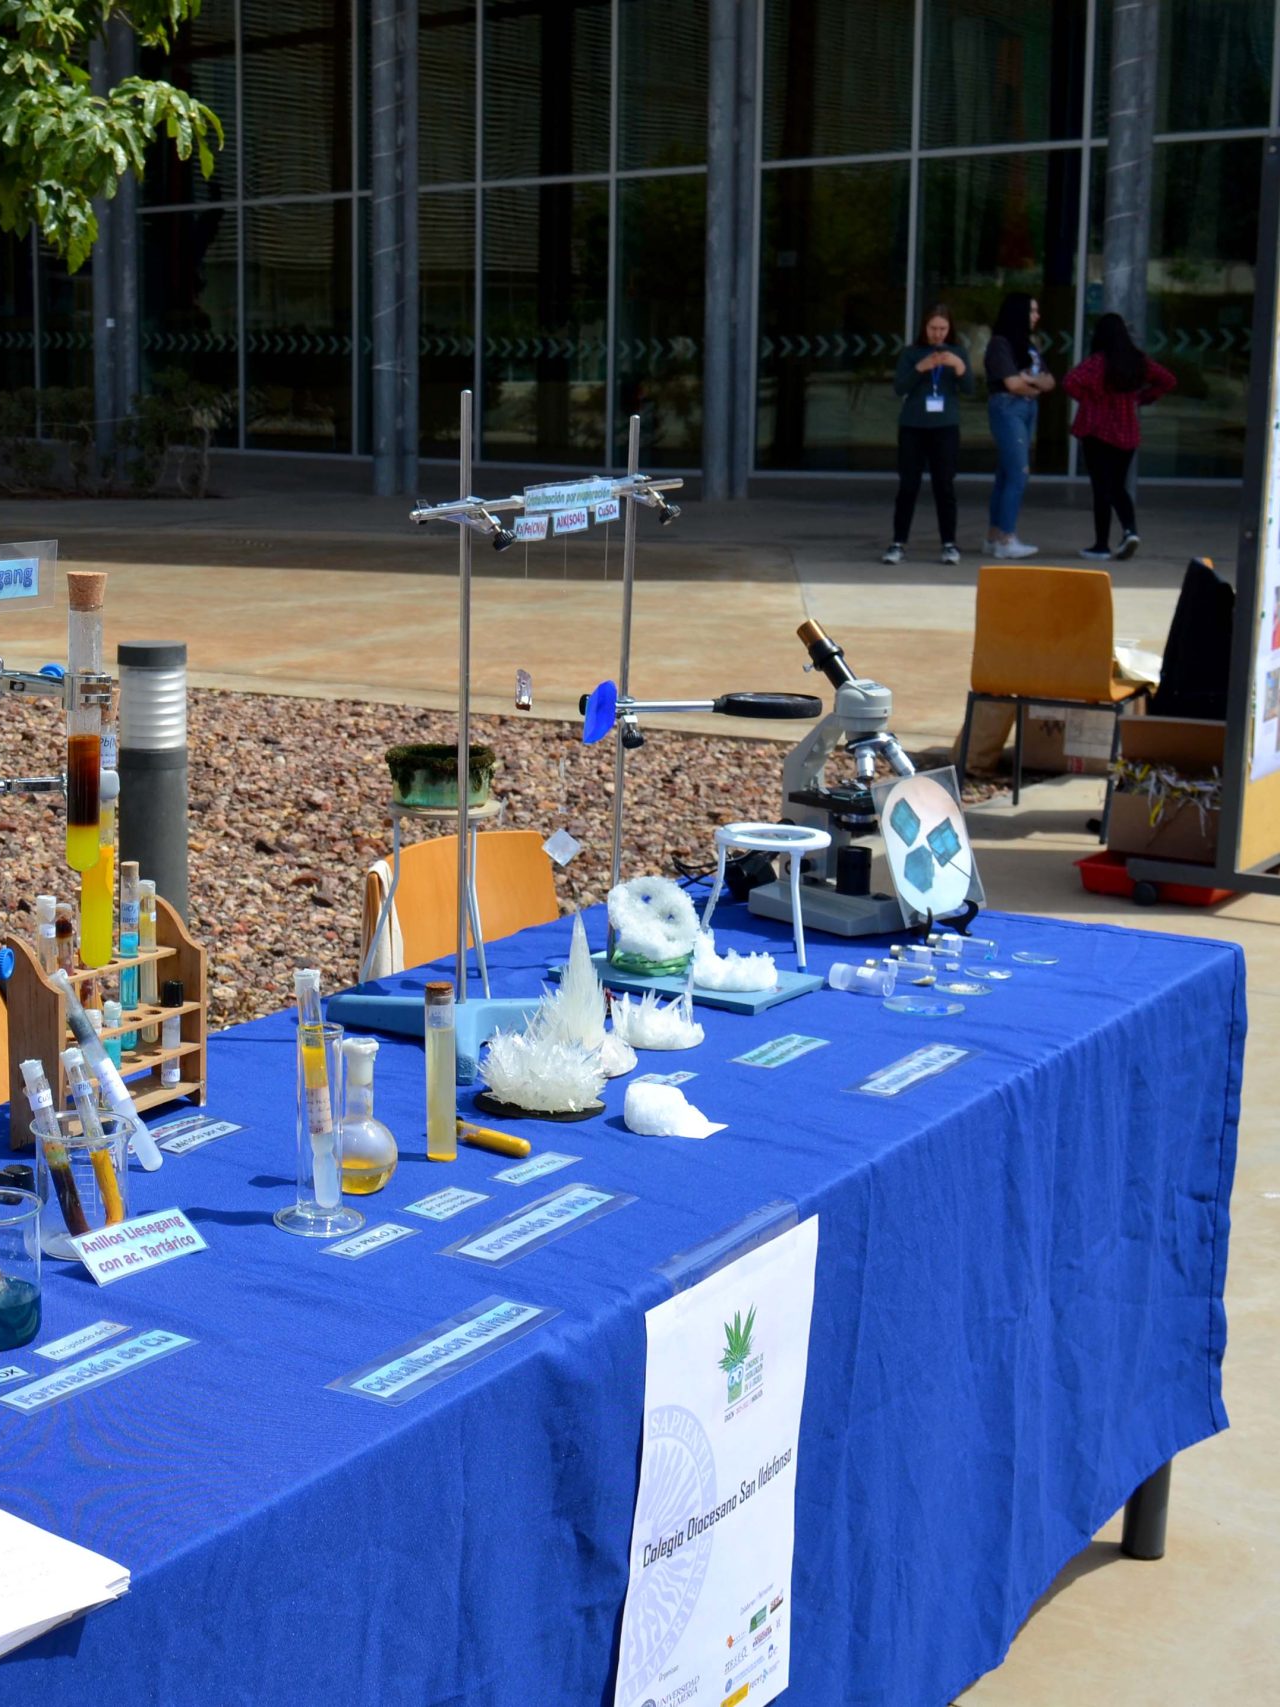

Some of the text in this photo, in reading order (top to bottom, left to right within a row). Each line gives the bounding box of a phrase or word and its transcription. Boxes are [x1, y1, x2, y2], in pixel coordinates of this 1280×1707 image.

[82, 1216, 185, 1253] Anillos Liesegang
[98, 1234, 195, 1273] con ac. Tartárico
[50, 1334, 95, 1356] Precipitado
[140, 1334, 173, 1347] Cu
[643, 1448, 791, 1568] Colegio Diocesano San Ildefonso
